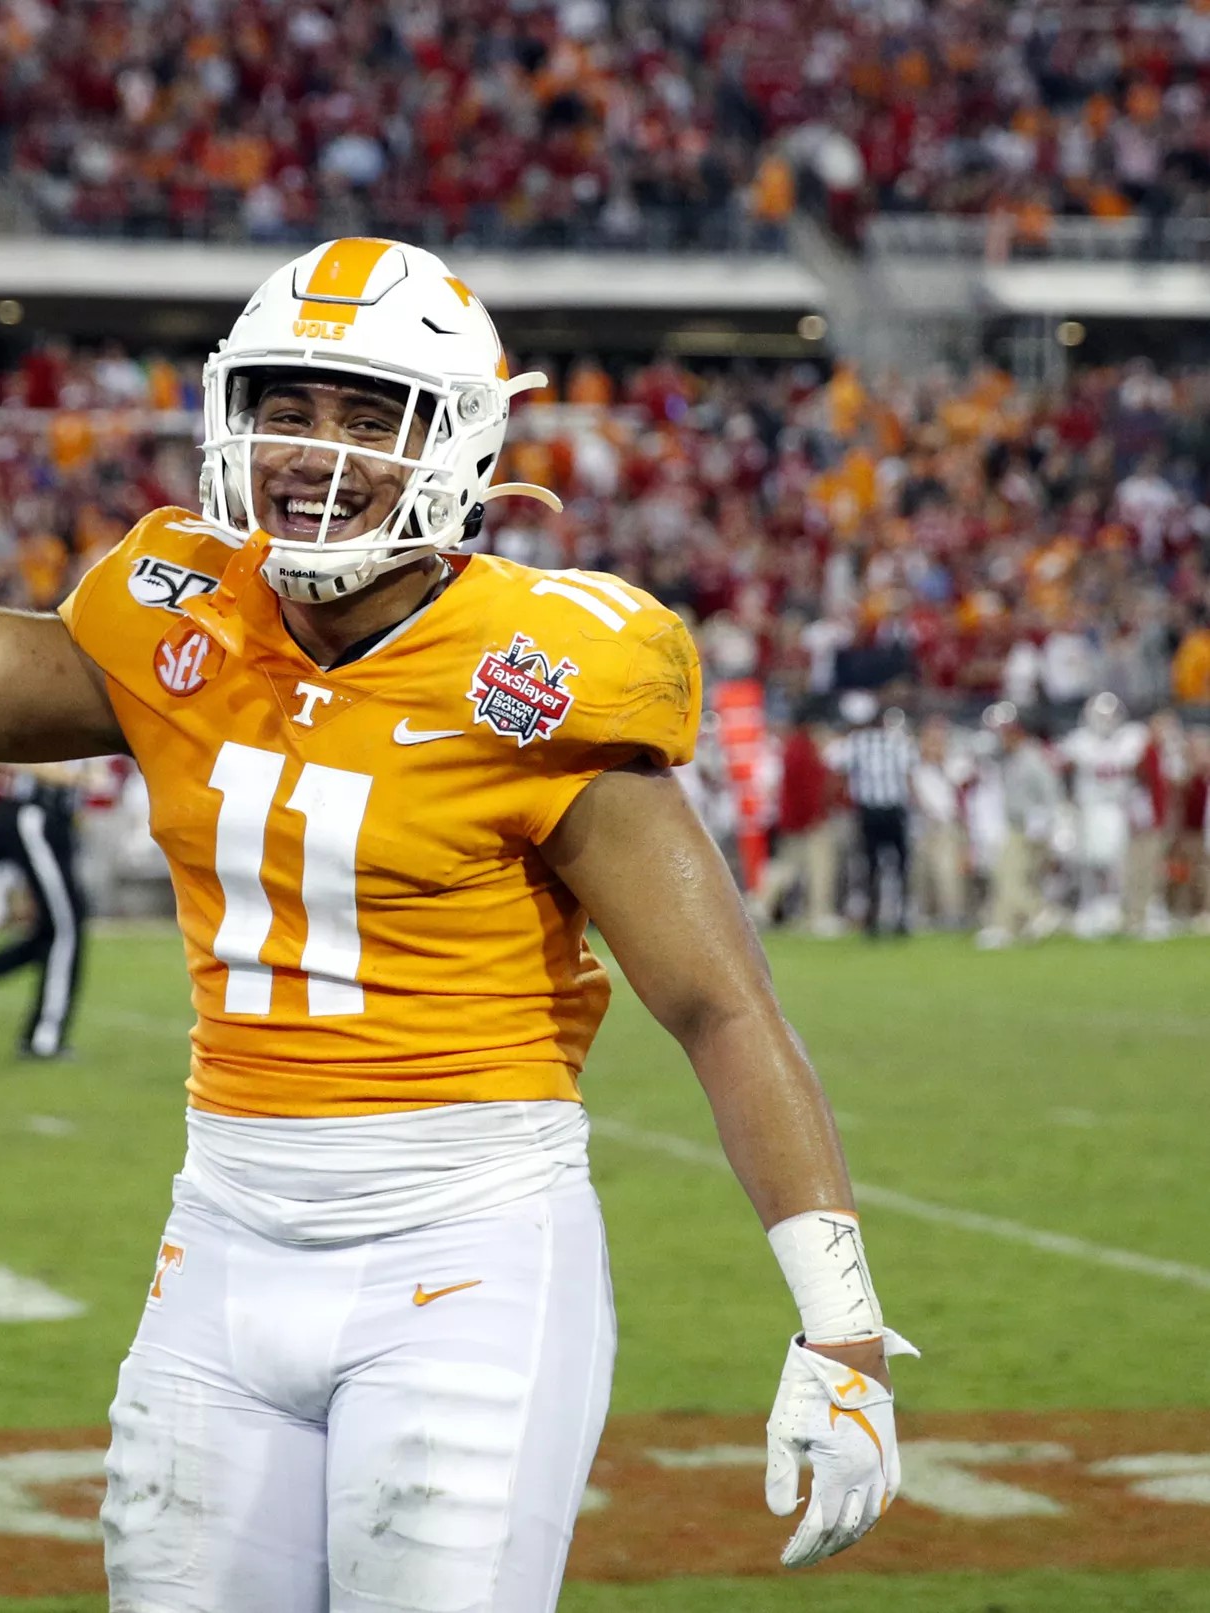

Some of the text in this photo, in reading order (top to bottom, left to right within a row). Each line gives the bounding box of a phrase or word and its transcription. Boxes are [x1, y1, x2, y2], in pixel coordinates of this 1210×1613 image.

[293, 320, 346, 341] VOLS
[530, 568, 642, 633] 11
[292, 681, 333, 726] T
[486, 661, 563, 710] TaxSlayer
[495, 690, 534, 719] GATOR
[491, 697, 530, 724] BOWL
[207, 740, 373, 1017] 11
